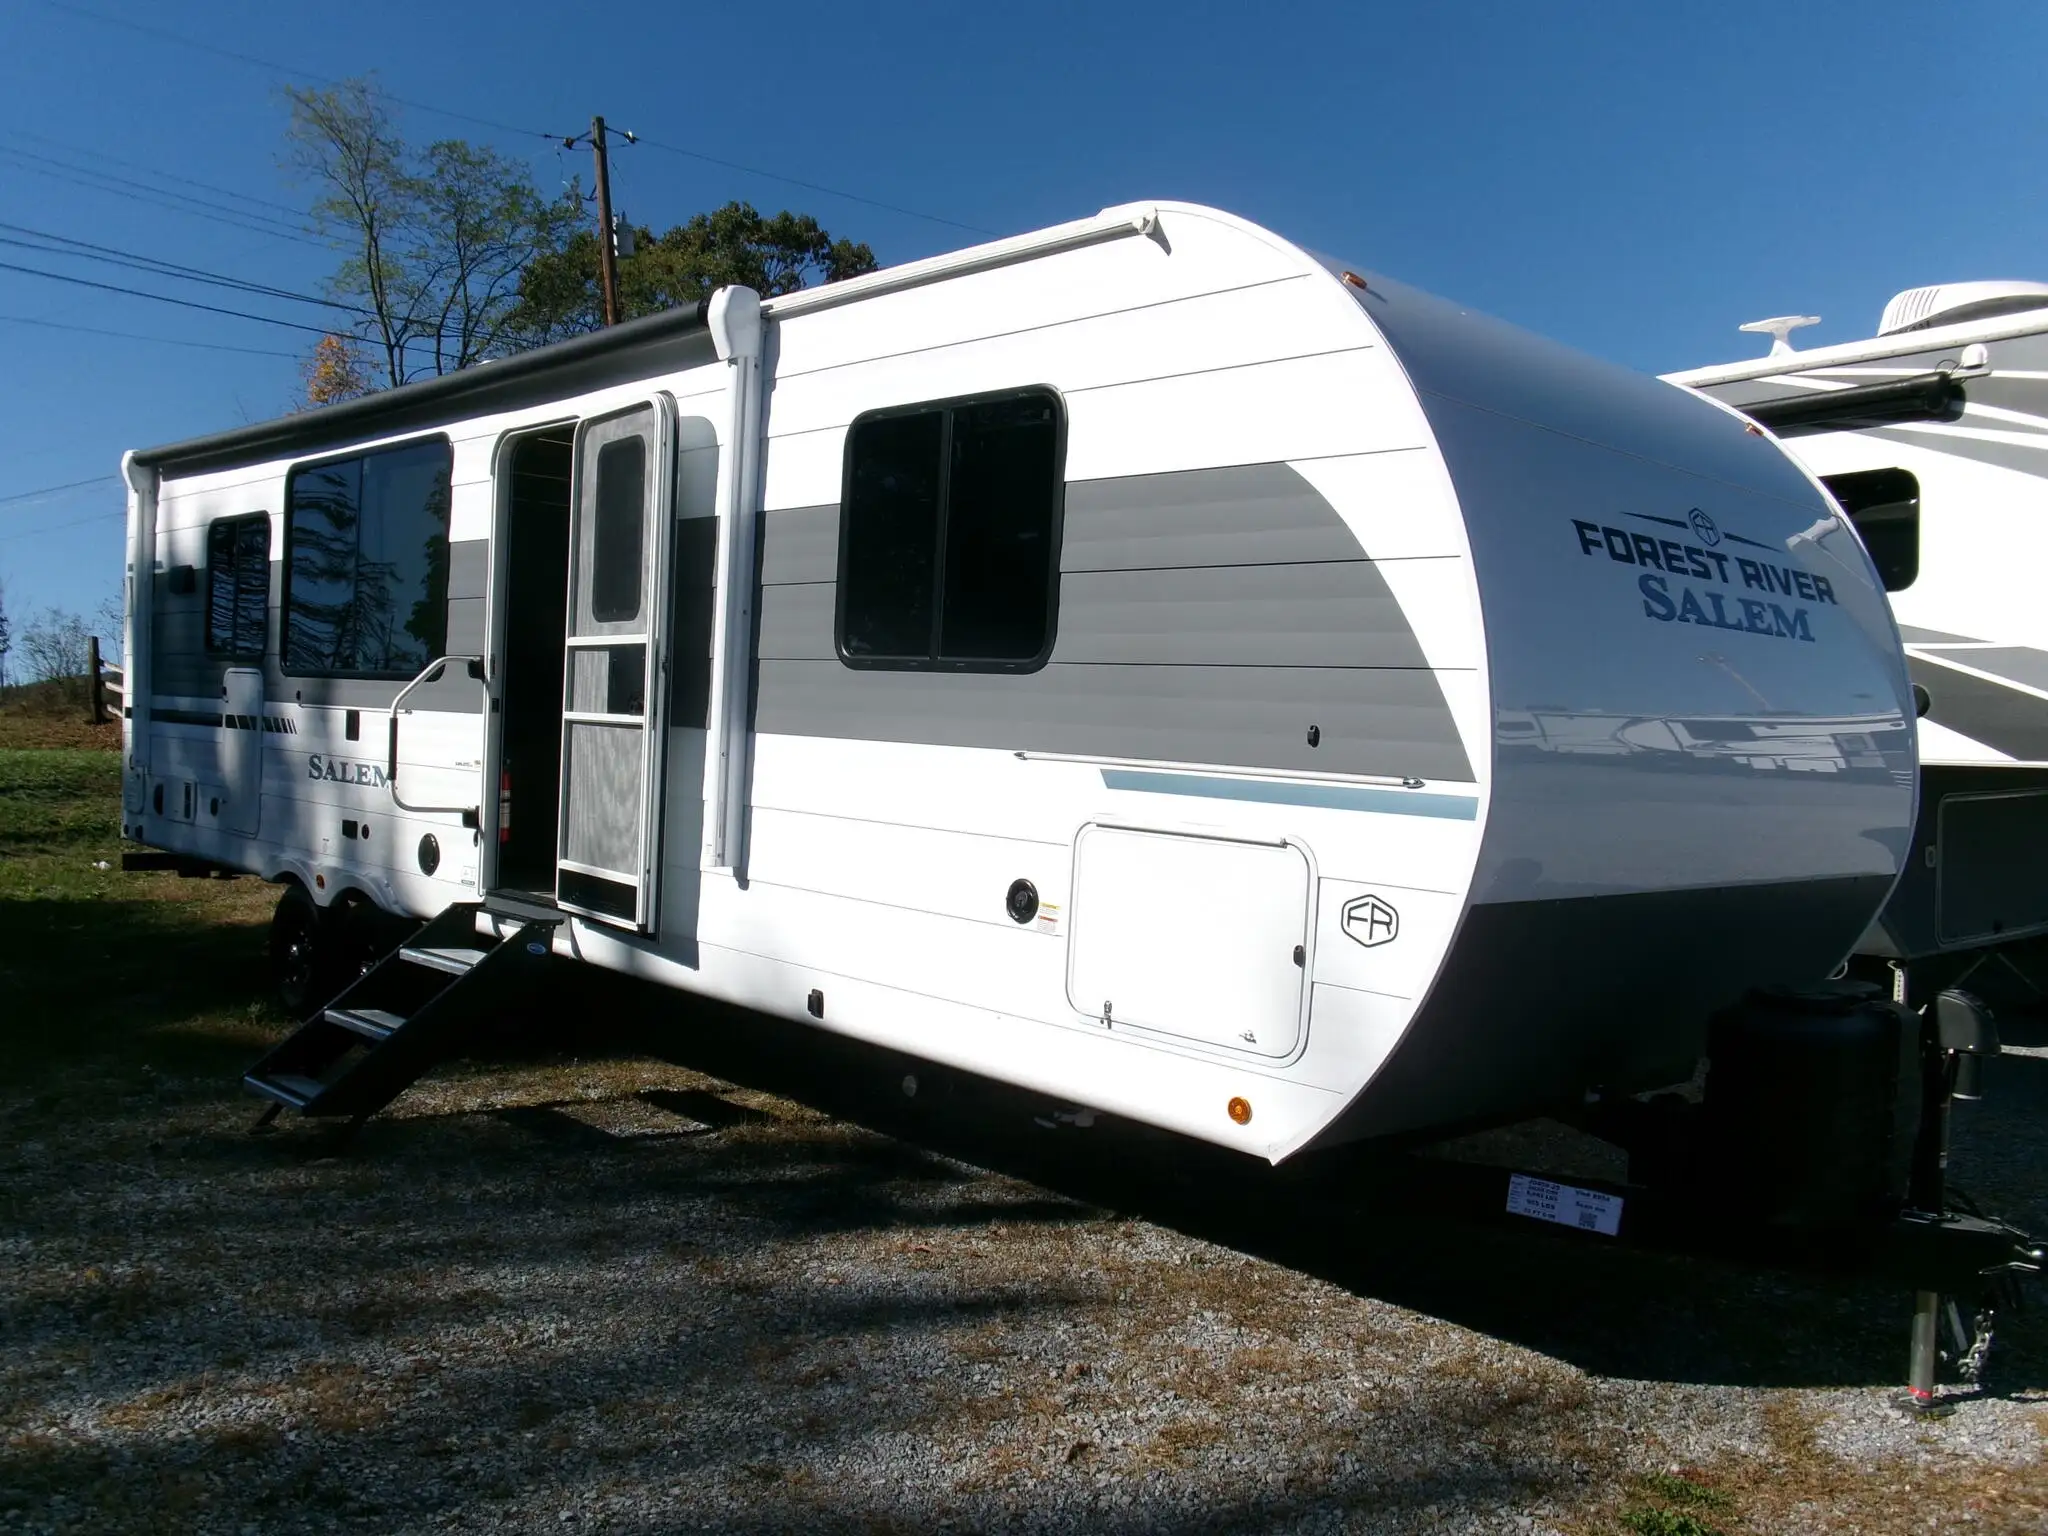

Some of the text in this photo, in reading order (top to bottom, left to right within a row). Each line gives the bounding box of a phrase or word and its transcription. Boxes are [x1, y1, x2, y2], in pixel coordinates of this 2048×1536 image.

[1571, 519, 1838, 605] FOREST RIVER
[1638, 573, 1815, 642] SALEM
